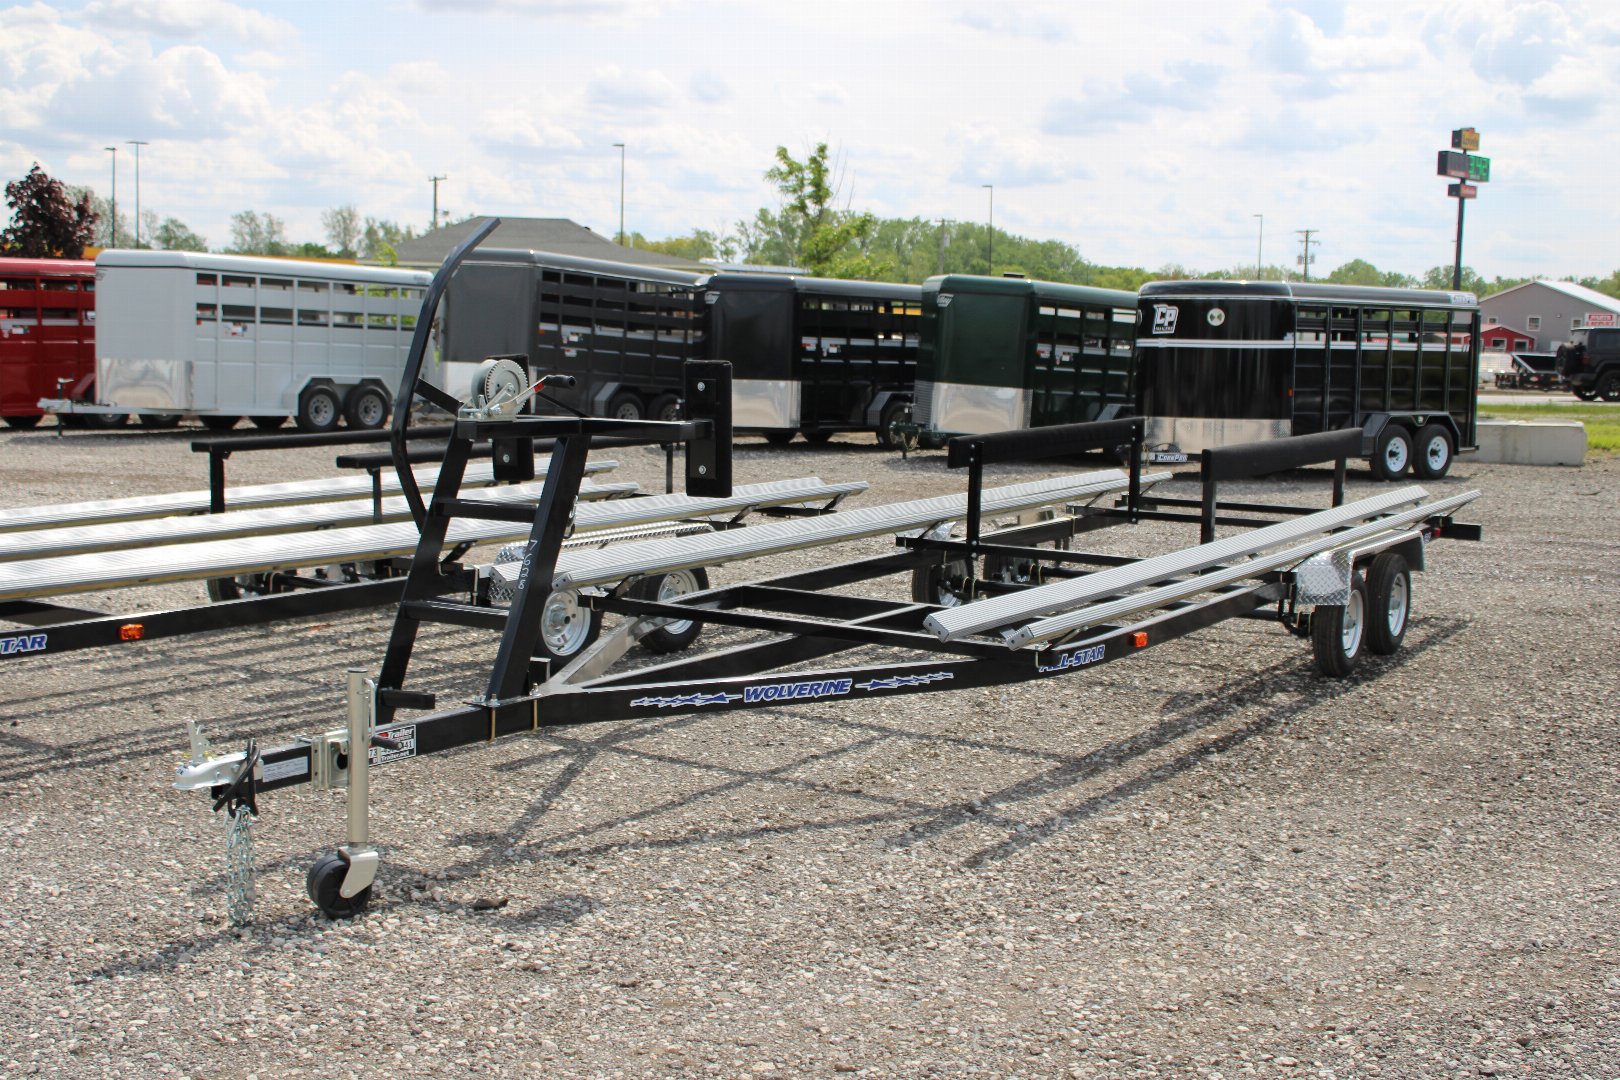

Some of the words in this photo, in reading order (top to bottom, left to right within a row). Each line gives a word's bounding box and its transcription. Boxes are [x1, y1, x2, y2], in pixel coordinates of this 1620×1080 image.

[1038, 644, 1106, 673] L-STAR
[744, 679, 852, 702] WOLVERINE
[388, 728, 414, 739] Trailer
